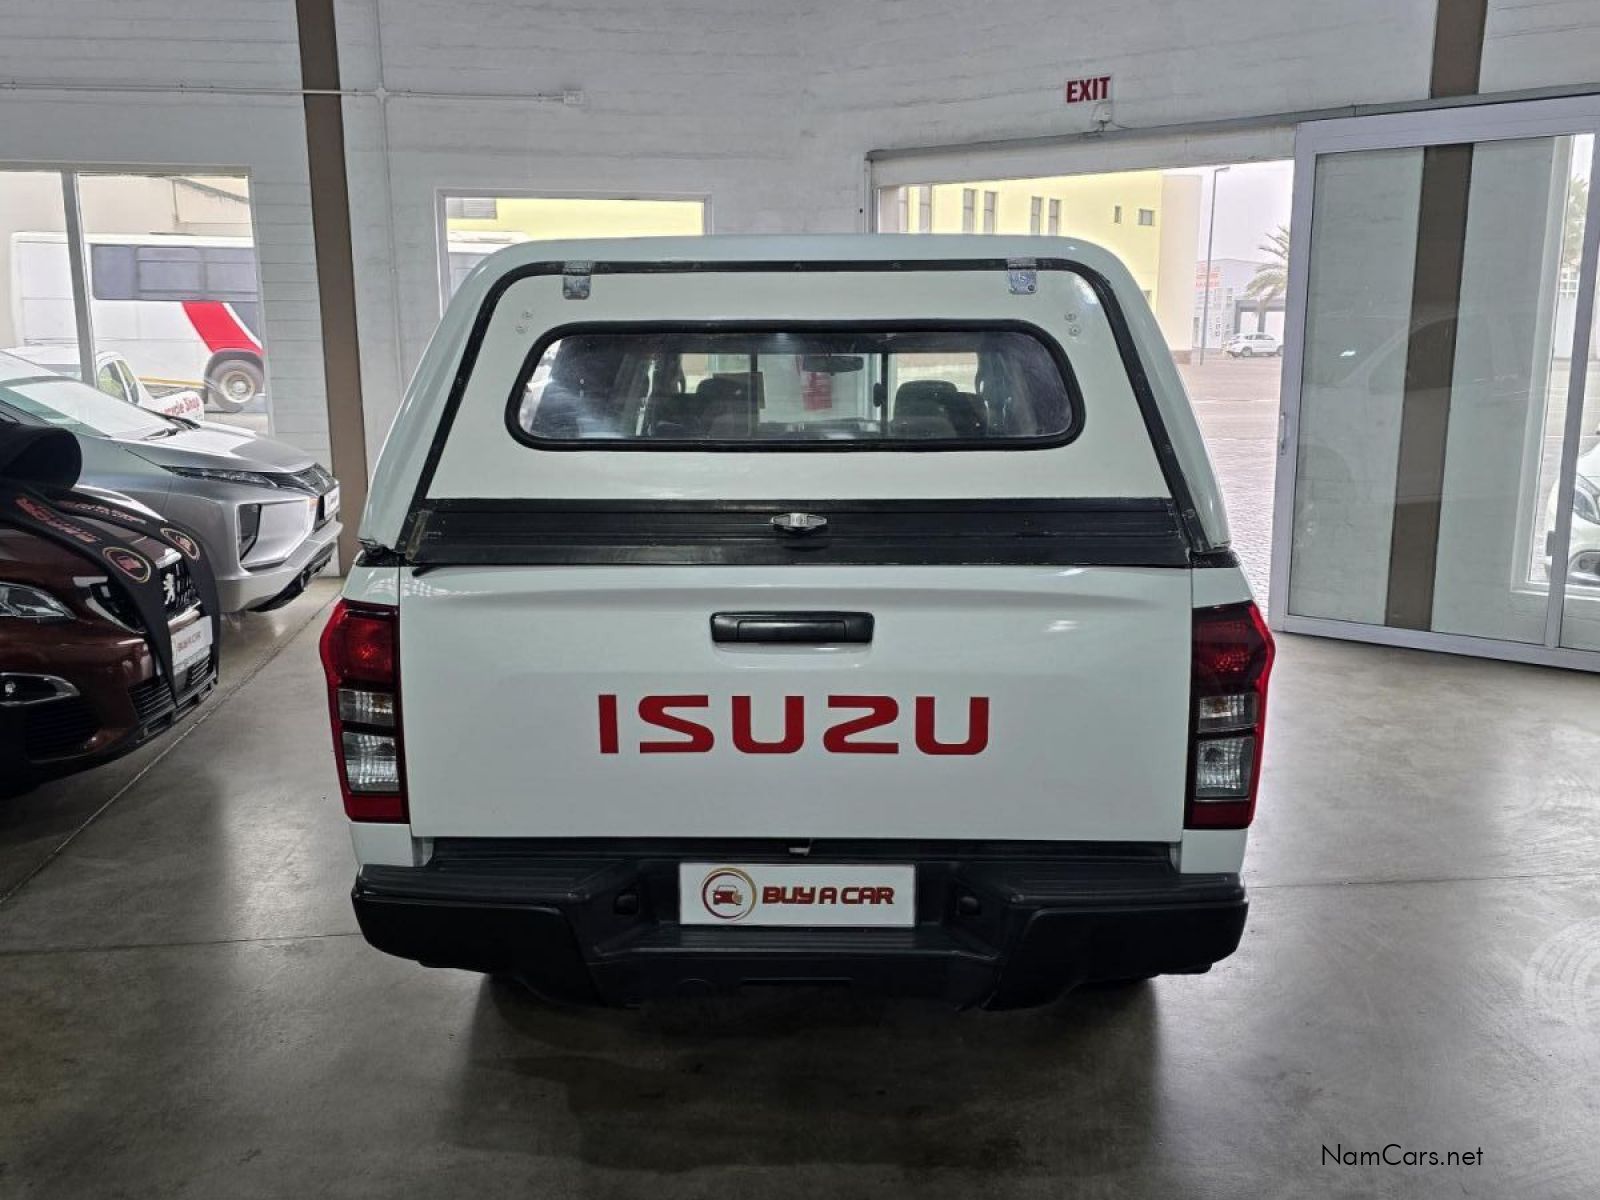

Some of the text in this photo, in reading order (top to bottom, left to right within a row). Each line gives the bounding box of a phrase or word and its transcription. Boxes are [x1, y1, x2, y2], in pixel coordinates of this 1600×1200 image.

[1067, 76, 1111, 103] EXIT
[598, 694, 990, 755] ISUZU
[762, 886, 895, 905] BUY A CAR
